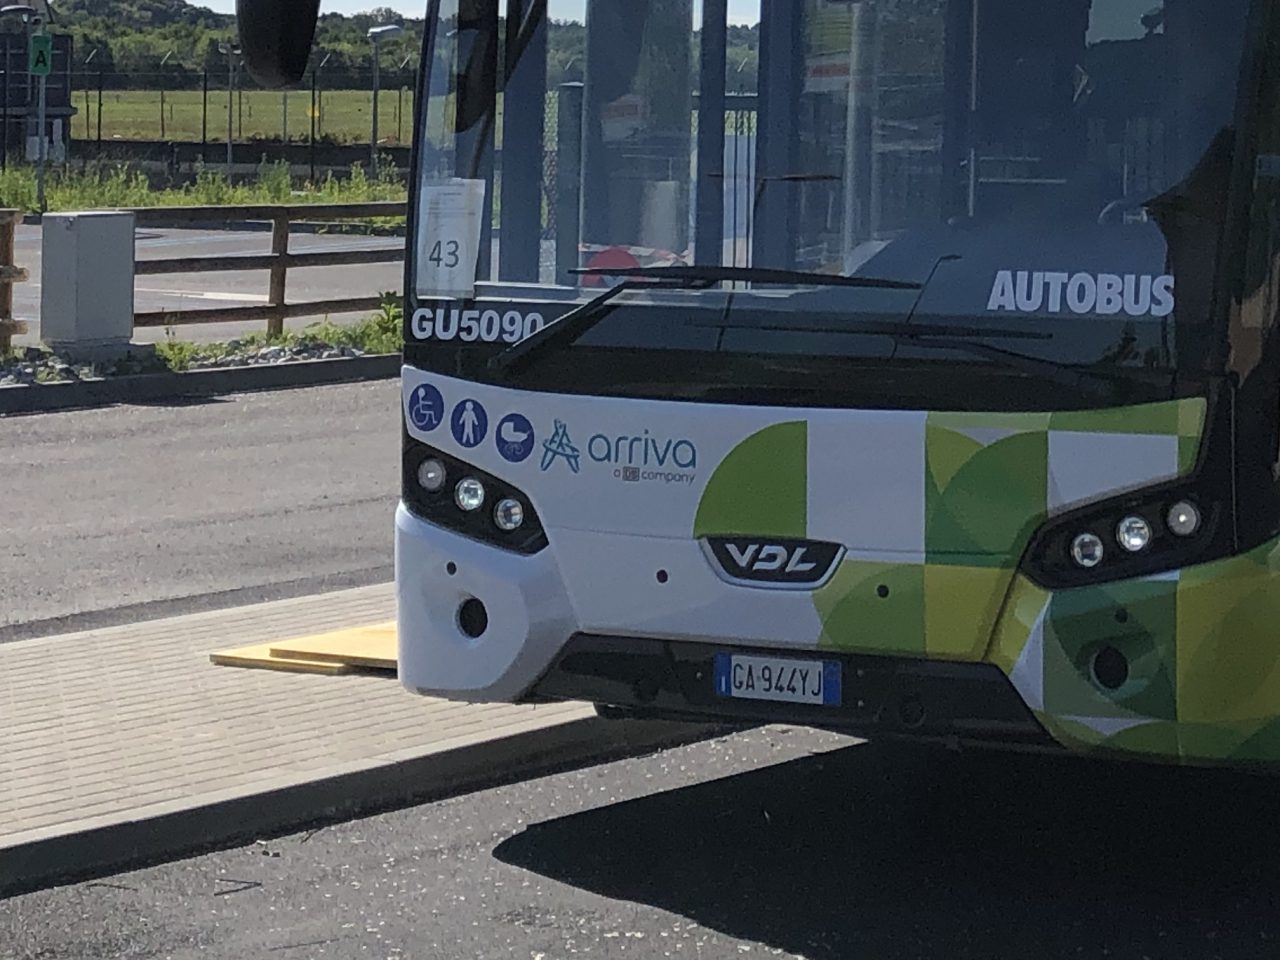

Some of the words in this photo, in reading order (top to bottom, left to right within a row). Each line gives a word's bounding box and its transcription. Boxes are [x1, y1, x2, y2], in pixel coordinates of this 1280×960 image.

[34, 50, 47, 67] A
[429, 240, 459, 268] 43
[986, 270, 1175, 317] AUTOBUS
[411, 307, 544, 342] GU5090
[587, 429, 696, 469] arriva
[641, 471, 696, 486] company
[725, 543, 817, 572] VDL
